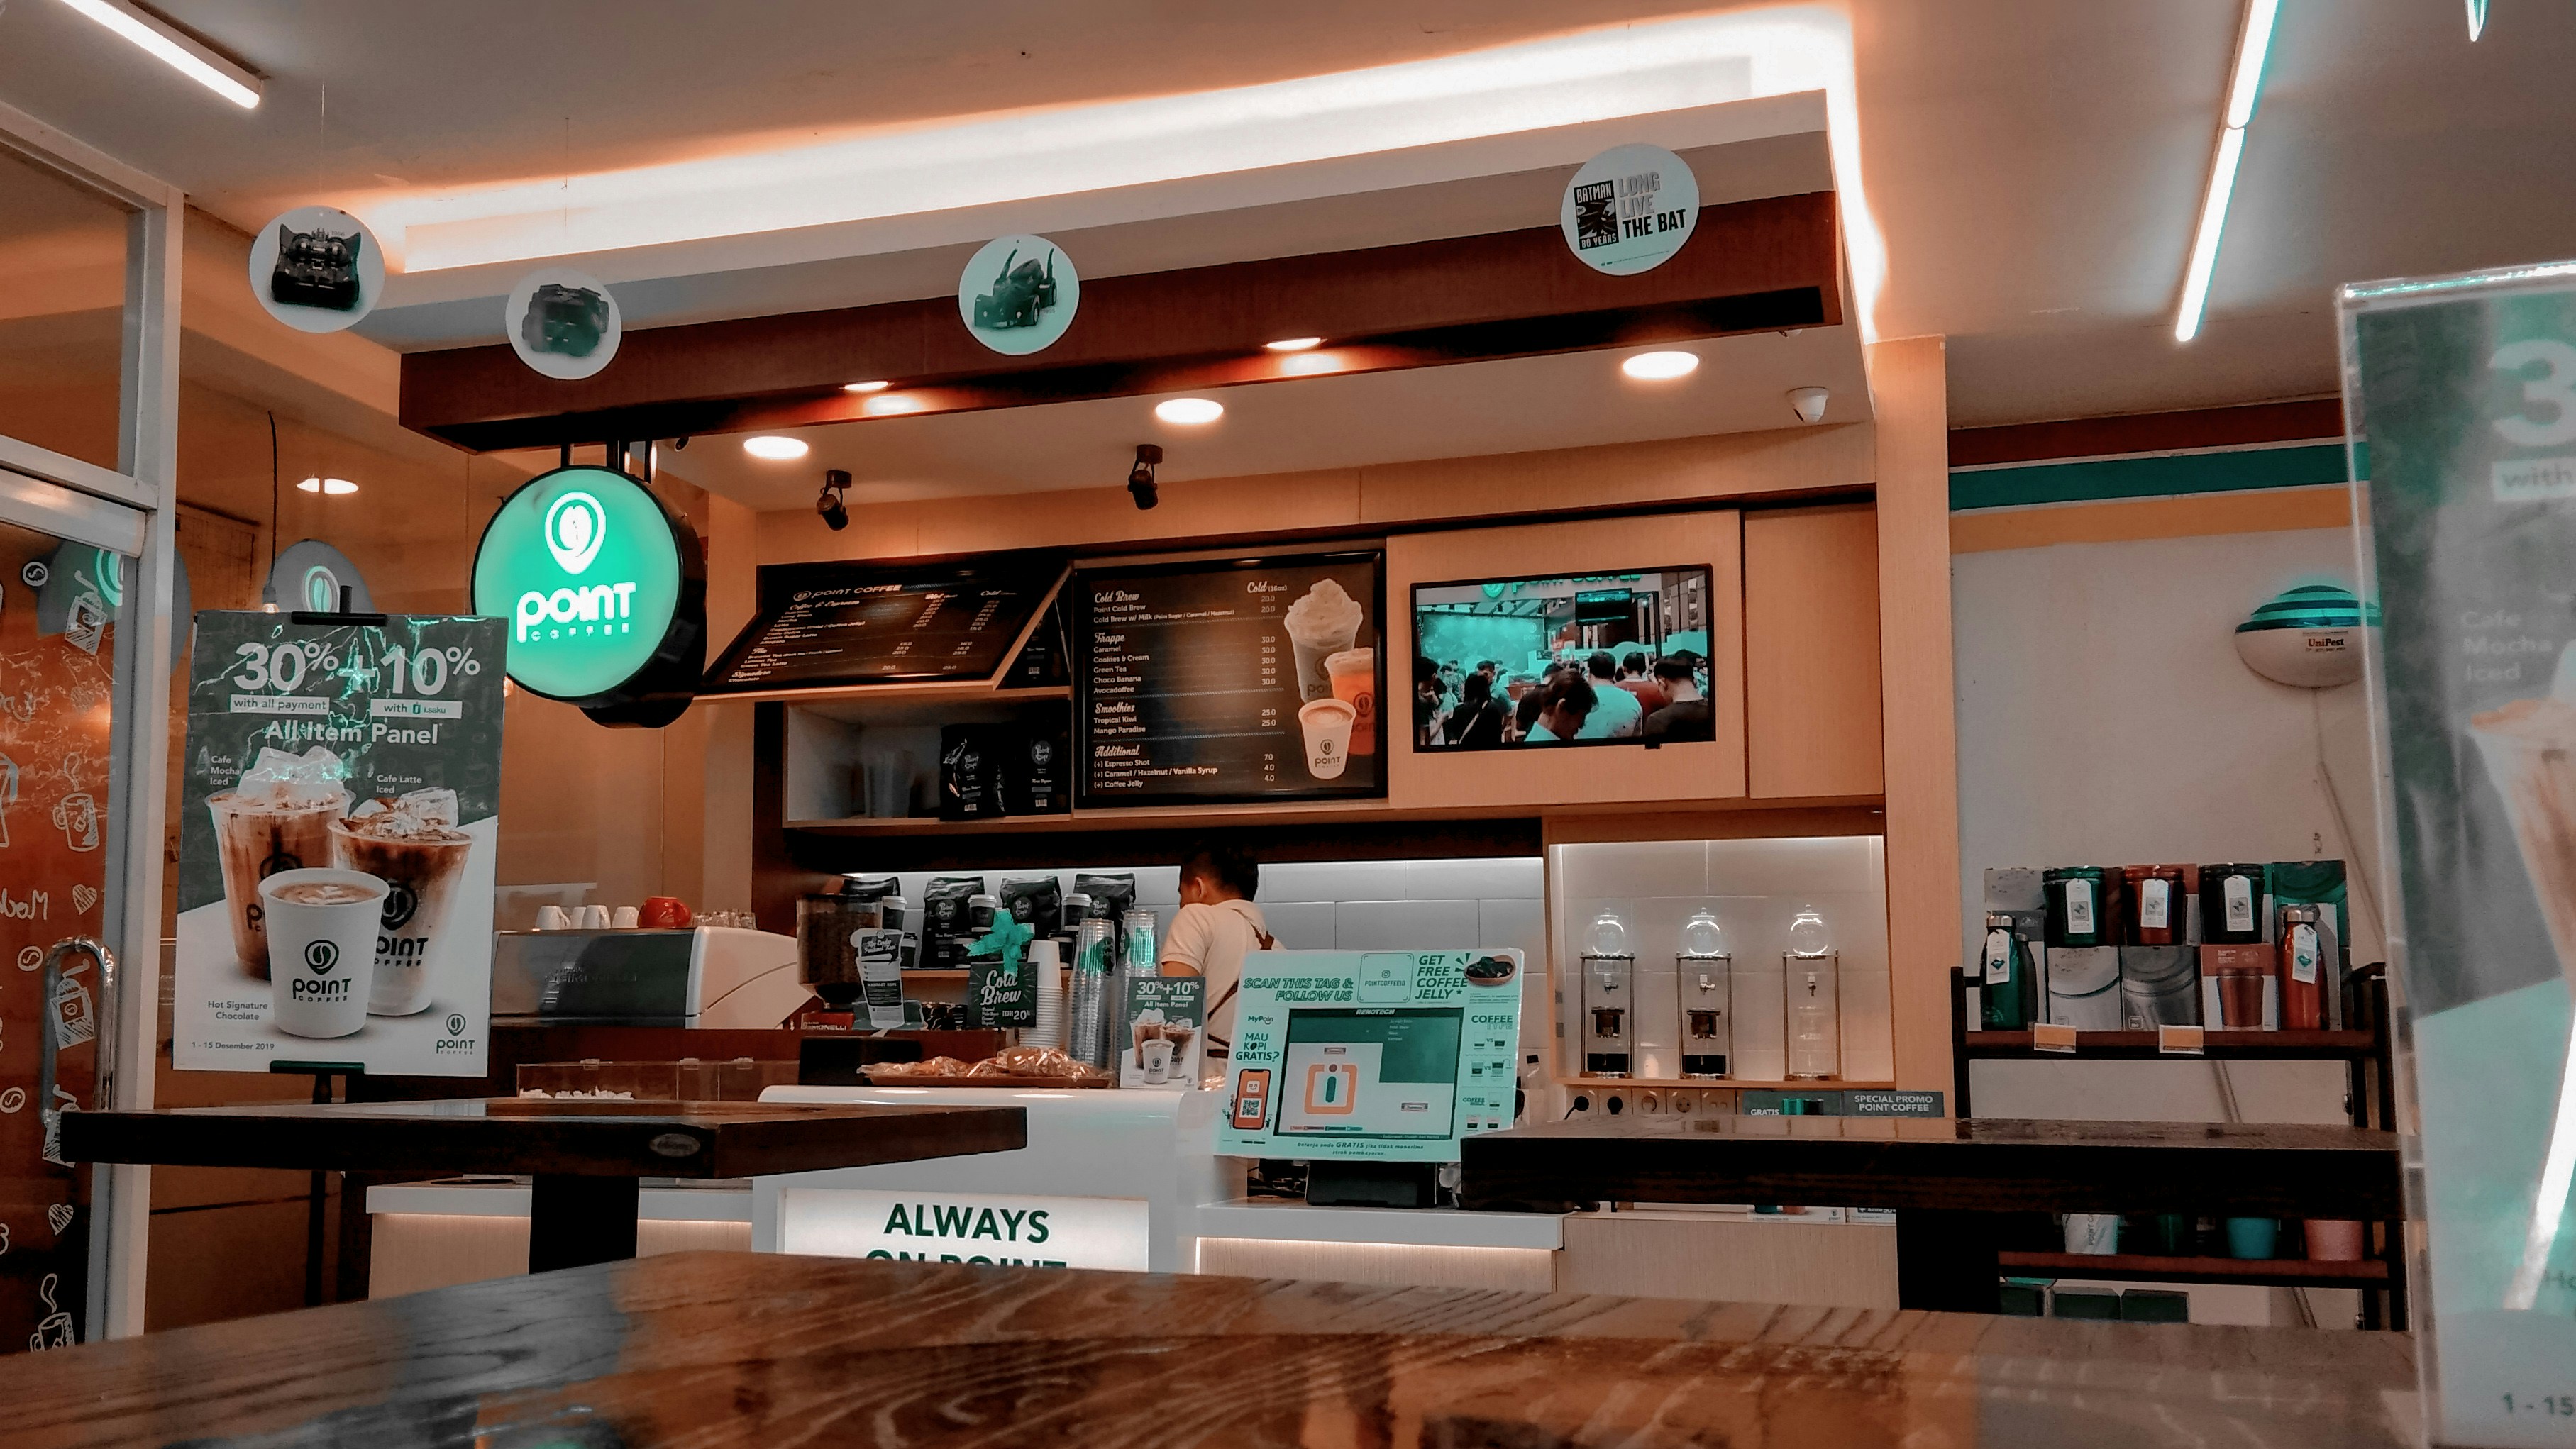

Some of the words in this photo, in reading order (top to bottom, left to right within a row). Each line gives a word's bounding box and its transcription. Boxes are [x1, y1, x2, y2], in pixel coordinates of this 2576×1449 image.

[1618, 172, 1661, 197] LONG
[1576, 183, 1612, 204] BATMAN
[1620, 194, 1654, 219] LIVE
[1623, 216, 1653, 238] THE
[1657, 209, 1686, 233] BAT
[1581, 239, 1591, 248] 80
[1594, 233, 1617, 246] YEARS
[2503, 465, 2573, 489] with
[854, 585, 902, 594] COFFEE
[1247, 581, 1268, 593] Cold
[1095, 591, 1113, 603] Cold
[1115, 590, 1139, 602] Brew
[2464, 610, 2521, 630] Cafe
[1095, 632, 1125, 645] Frappe
[2308, 638, 2344, 647] UniPest
[2464, 636, 2553, 655] Mocha
[2467, 661, 2521, 682] Iced
[233, 698, 258, 709] with
[261, 698, 275, 709] all
[277, 700, 326, 712] payment
[384, 704, 407, 713] with
[1095, 702, 1135, 714] Smoothies
[264, 720, 298, 740] All
[307, 721, 362, 743] Item
[372, 723, 438, 745] Panel
[1095, 745, 1140, 757] Additional
[211, 755, 231, 764] Cafe
[211, 766, 241, 775] Mocha
[1198, 767, 1217, 775] Syrup
[210, 777, 228, 786] Iced
[377, 775, 397, 784] Cafe
[399, 775, 422, 784] Latte
[376, 785, 395, 794] Iced
[1419, 955, 1445, 965] GET
[1417, 967, 1450, 976] FREE
[1174, 982, 1200, 994] 10%
[1243, 978, 1281, 989] SCAN
[1282, 977, 1312, 989] THIS
[1315, 977, 1341, 989] TAG
[1342, 978, 1354, 989] &
[1417, 978, 1468, 987] COFFEE
[980, 985, 1022, 1005] Brew
[1275, 990, 1334, 1001] FOLLOW
[1335, 990, 1353, 1001] US
[1415, 989, 1454, 999] JELLY
[227, 1001, 267, 1011] Signature
[216, 1011, 260, 1020] Chocolate
[1236, 1051, 1280, 1062] GRATIS?
[1896, 1095, 1933, 1104] PROMO
[1891, 1104, 1929, 1112] COFFEE
[883, 1203, 1050, 1243] ALWAYS
[2503, 1392, 2514, 1414] 1
[2543, 1396, 2575, 1416] 15
